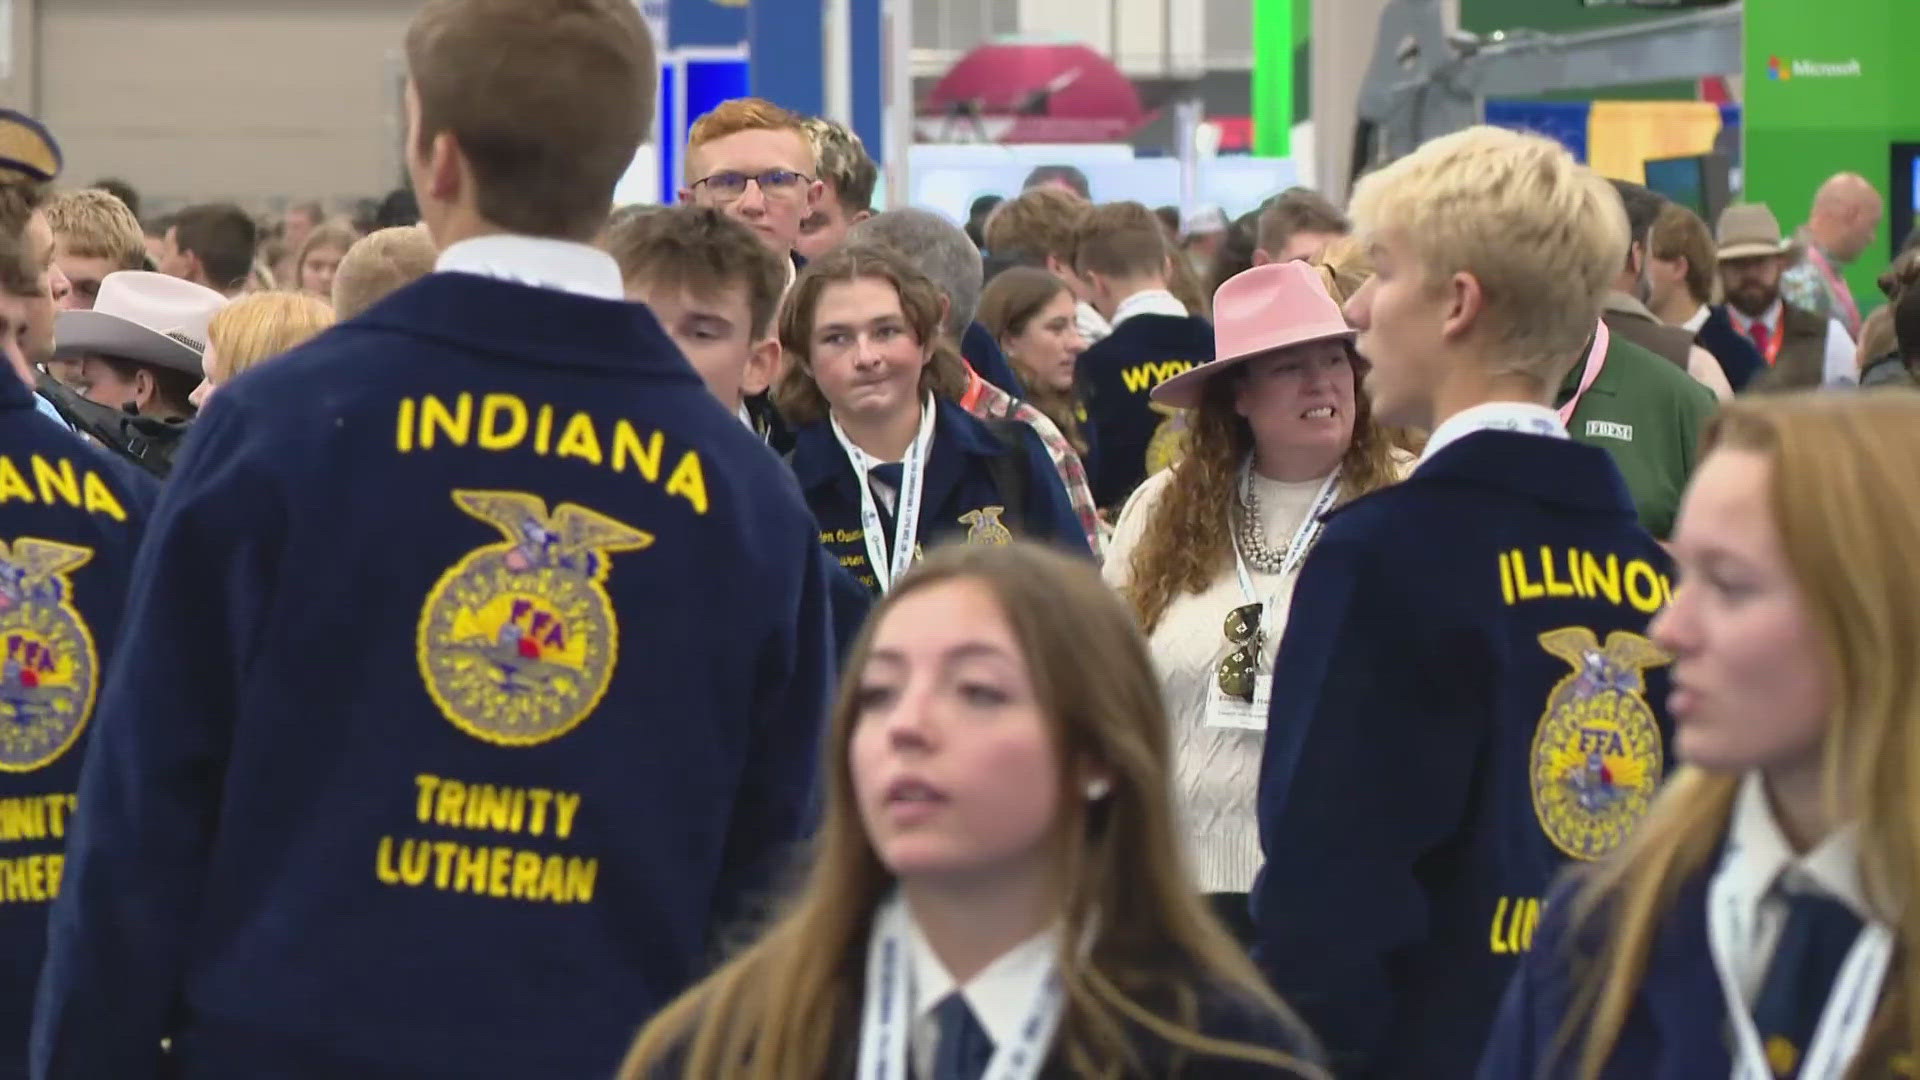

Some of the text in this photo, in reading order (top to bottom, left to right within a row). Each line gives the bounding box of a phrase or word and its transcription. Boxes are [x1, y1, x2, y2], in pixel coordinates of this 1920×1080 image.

[1792, 58, 1861, 77] Microsoft
[1121, 360, 1204, 393] WYO
[396, 391, 708, 514] INDIANA
[1499, 545, 1682, 614] ILLINOI
[511, 599, 565, 652] FFA
[8, 635, 55, 672] FFA
[1580, 728, 1625, 757] FFA
[414, 773, 581, 840] TRINITY
[376, 835, 598, 904] LUTHERAN
